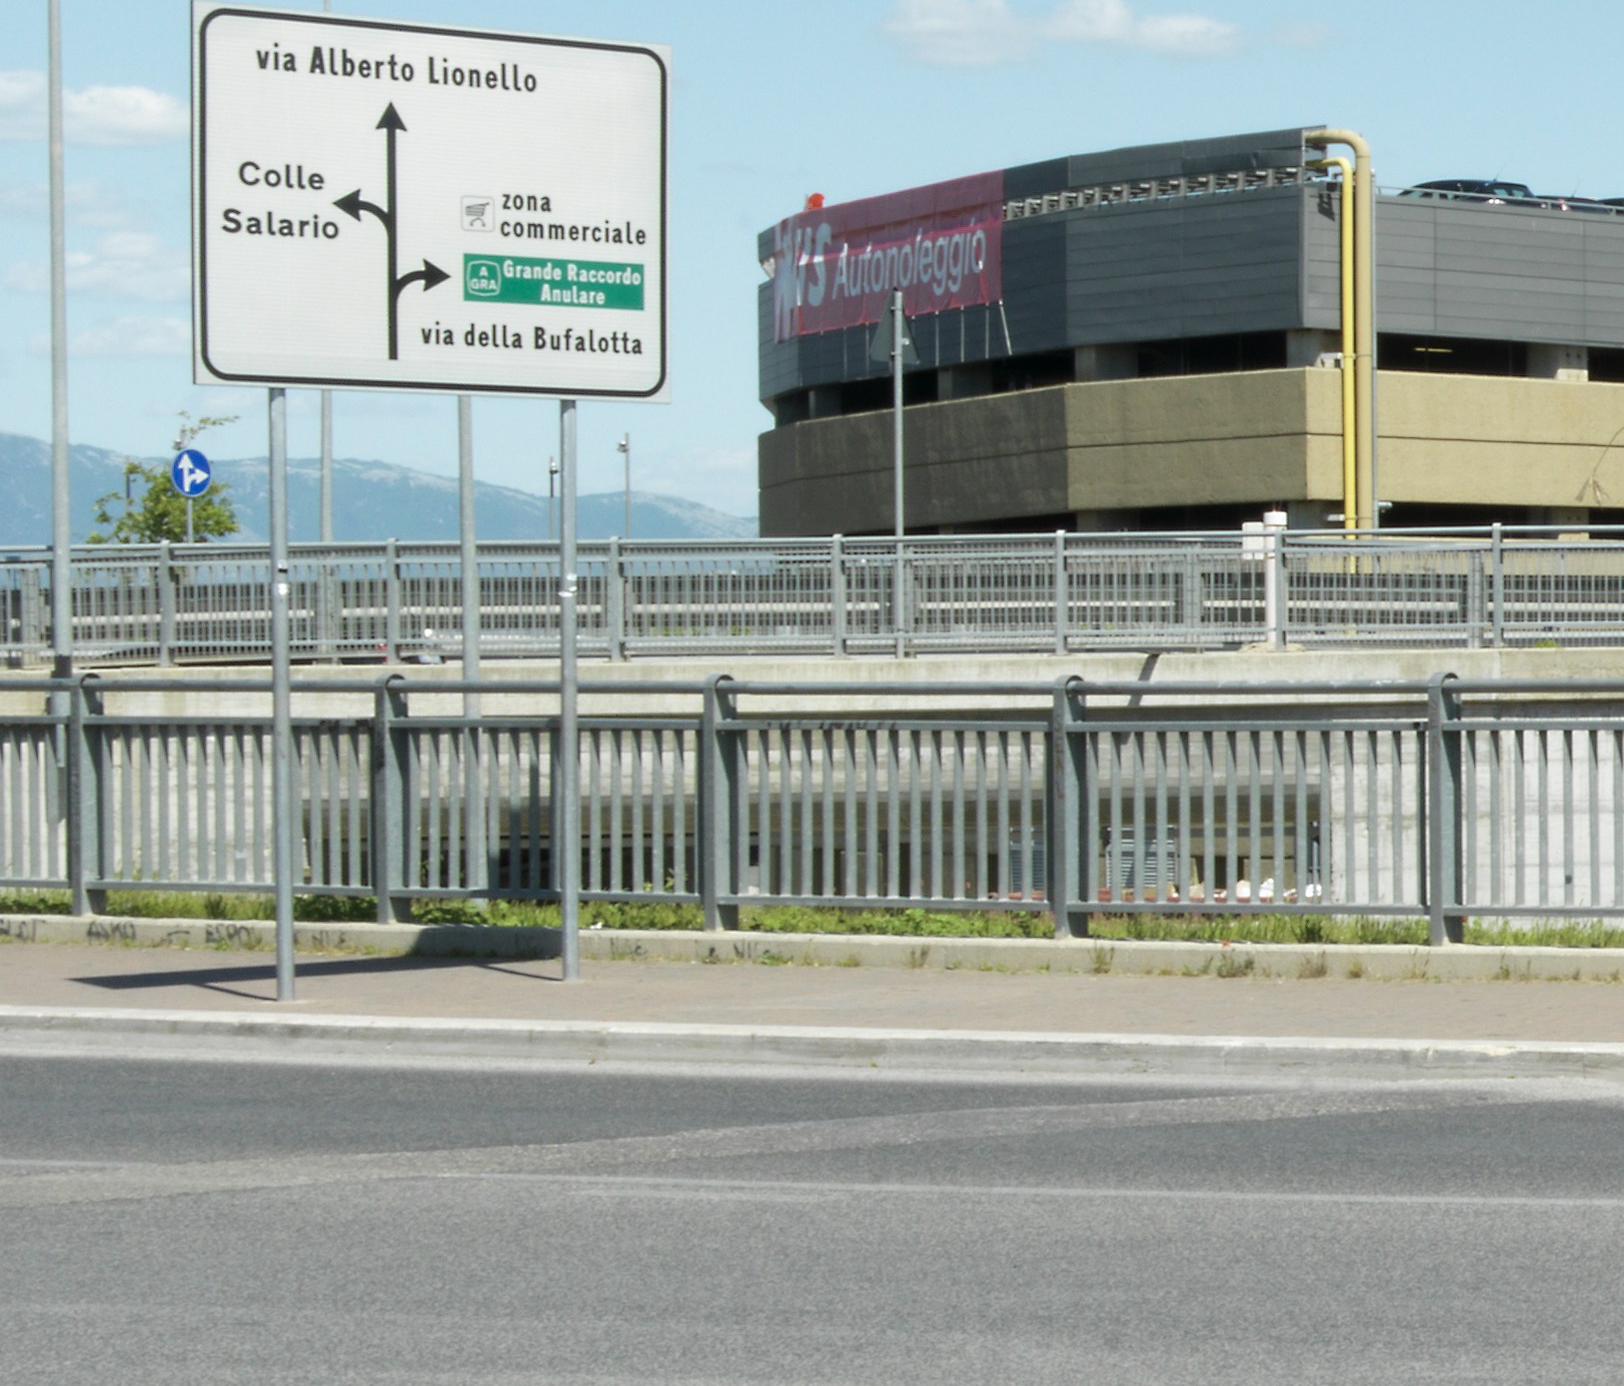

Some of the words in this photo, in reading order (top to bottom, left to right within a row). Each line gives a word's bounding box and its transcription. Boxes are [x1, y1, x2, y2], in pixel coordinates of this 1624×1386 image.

[256, 42, 297, 72] via
[309, 45, 414, 82] Alberto
[428, 56, 537, 93] Lionello
[238, 161, 325, 191] Colle
[502, 193, 552, 212] zona
[221, 208, 339, 239] Salario
[500, 219, 646, 245] commerciale
[479, 266, 489, 277] A
[503, 259, 562, 281] Grande
[567, 263, 642, 286] Raccordo
[832, 218, 987, 300] Autonoleggio
[470, 278, 498, 290] GRA
[540, 283, 606, 305] Anulare
[421, 320, 455, 346] via
[464, 322, 523, 349] della
[534, 326, 643, 355] Bufalotta
